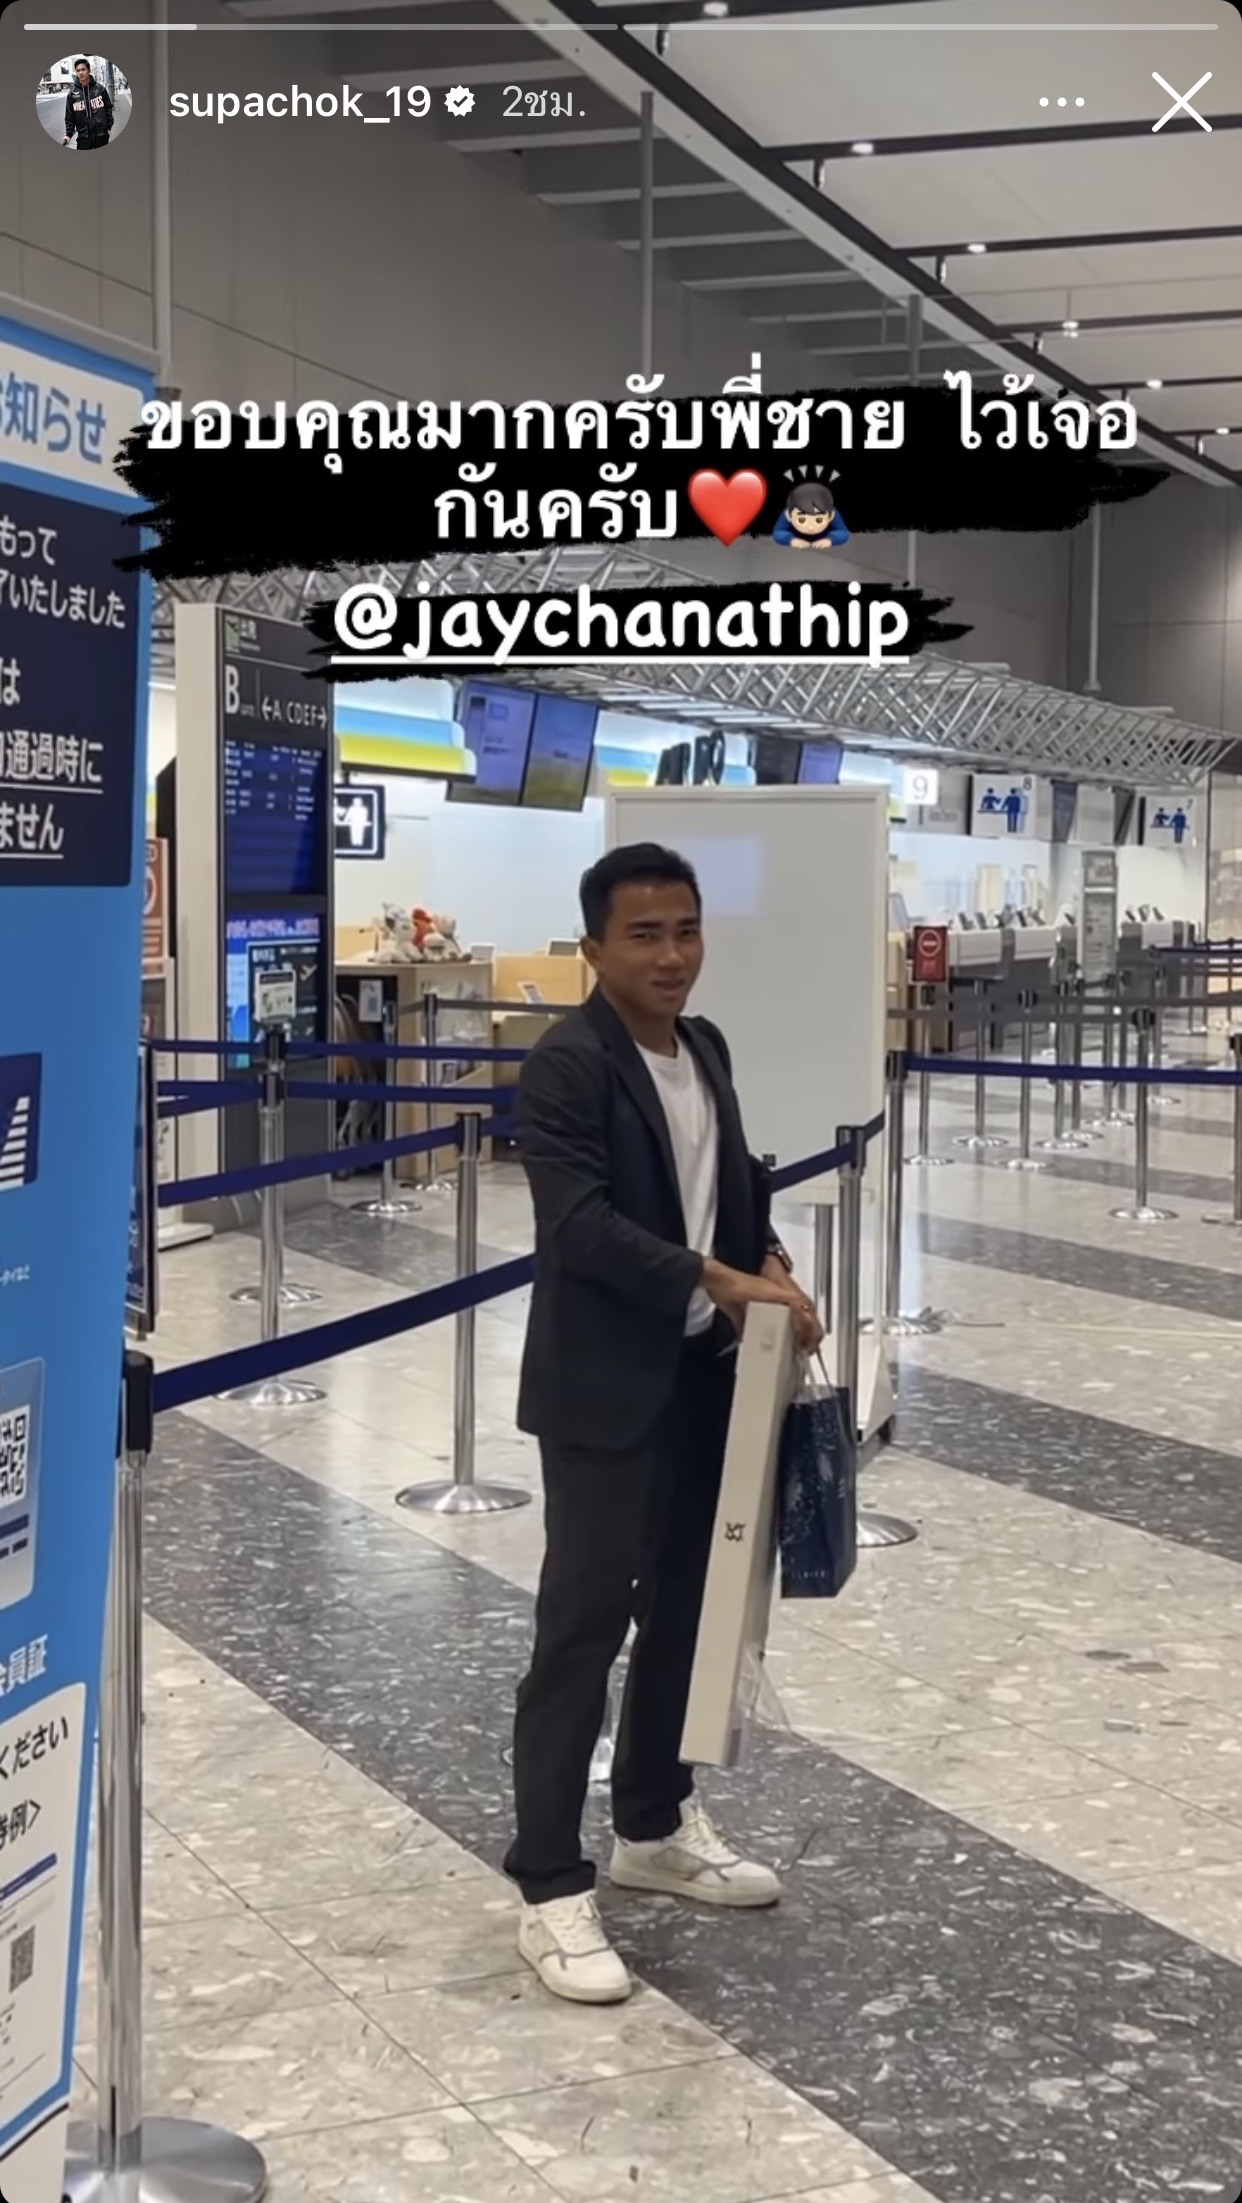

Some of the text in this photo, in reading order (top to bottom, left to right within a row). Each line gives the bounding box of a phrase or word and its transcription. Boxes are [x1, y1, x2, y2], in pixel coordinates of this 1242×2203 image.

[0, 371, 106, 464] 知らせ
[225, 664, 240, 715] B
[0, 729, 104, 783] 通過時に
[912, 775, 929, 800] 9
[1023, 777, 1032, 790] 8
[0, 801, 64, 851] ません
